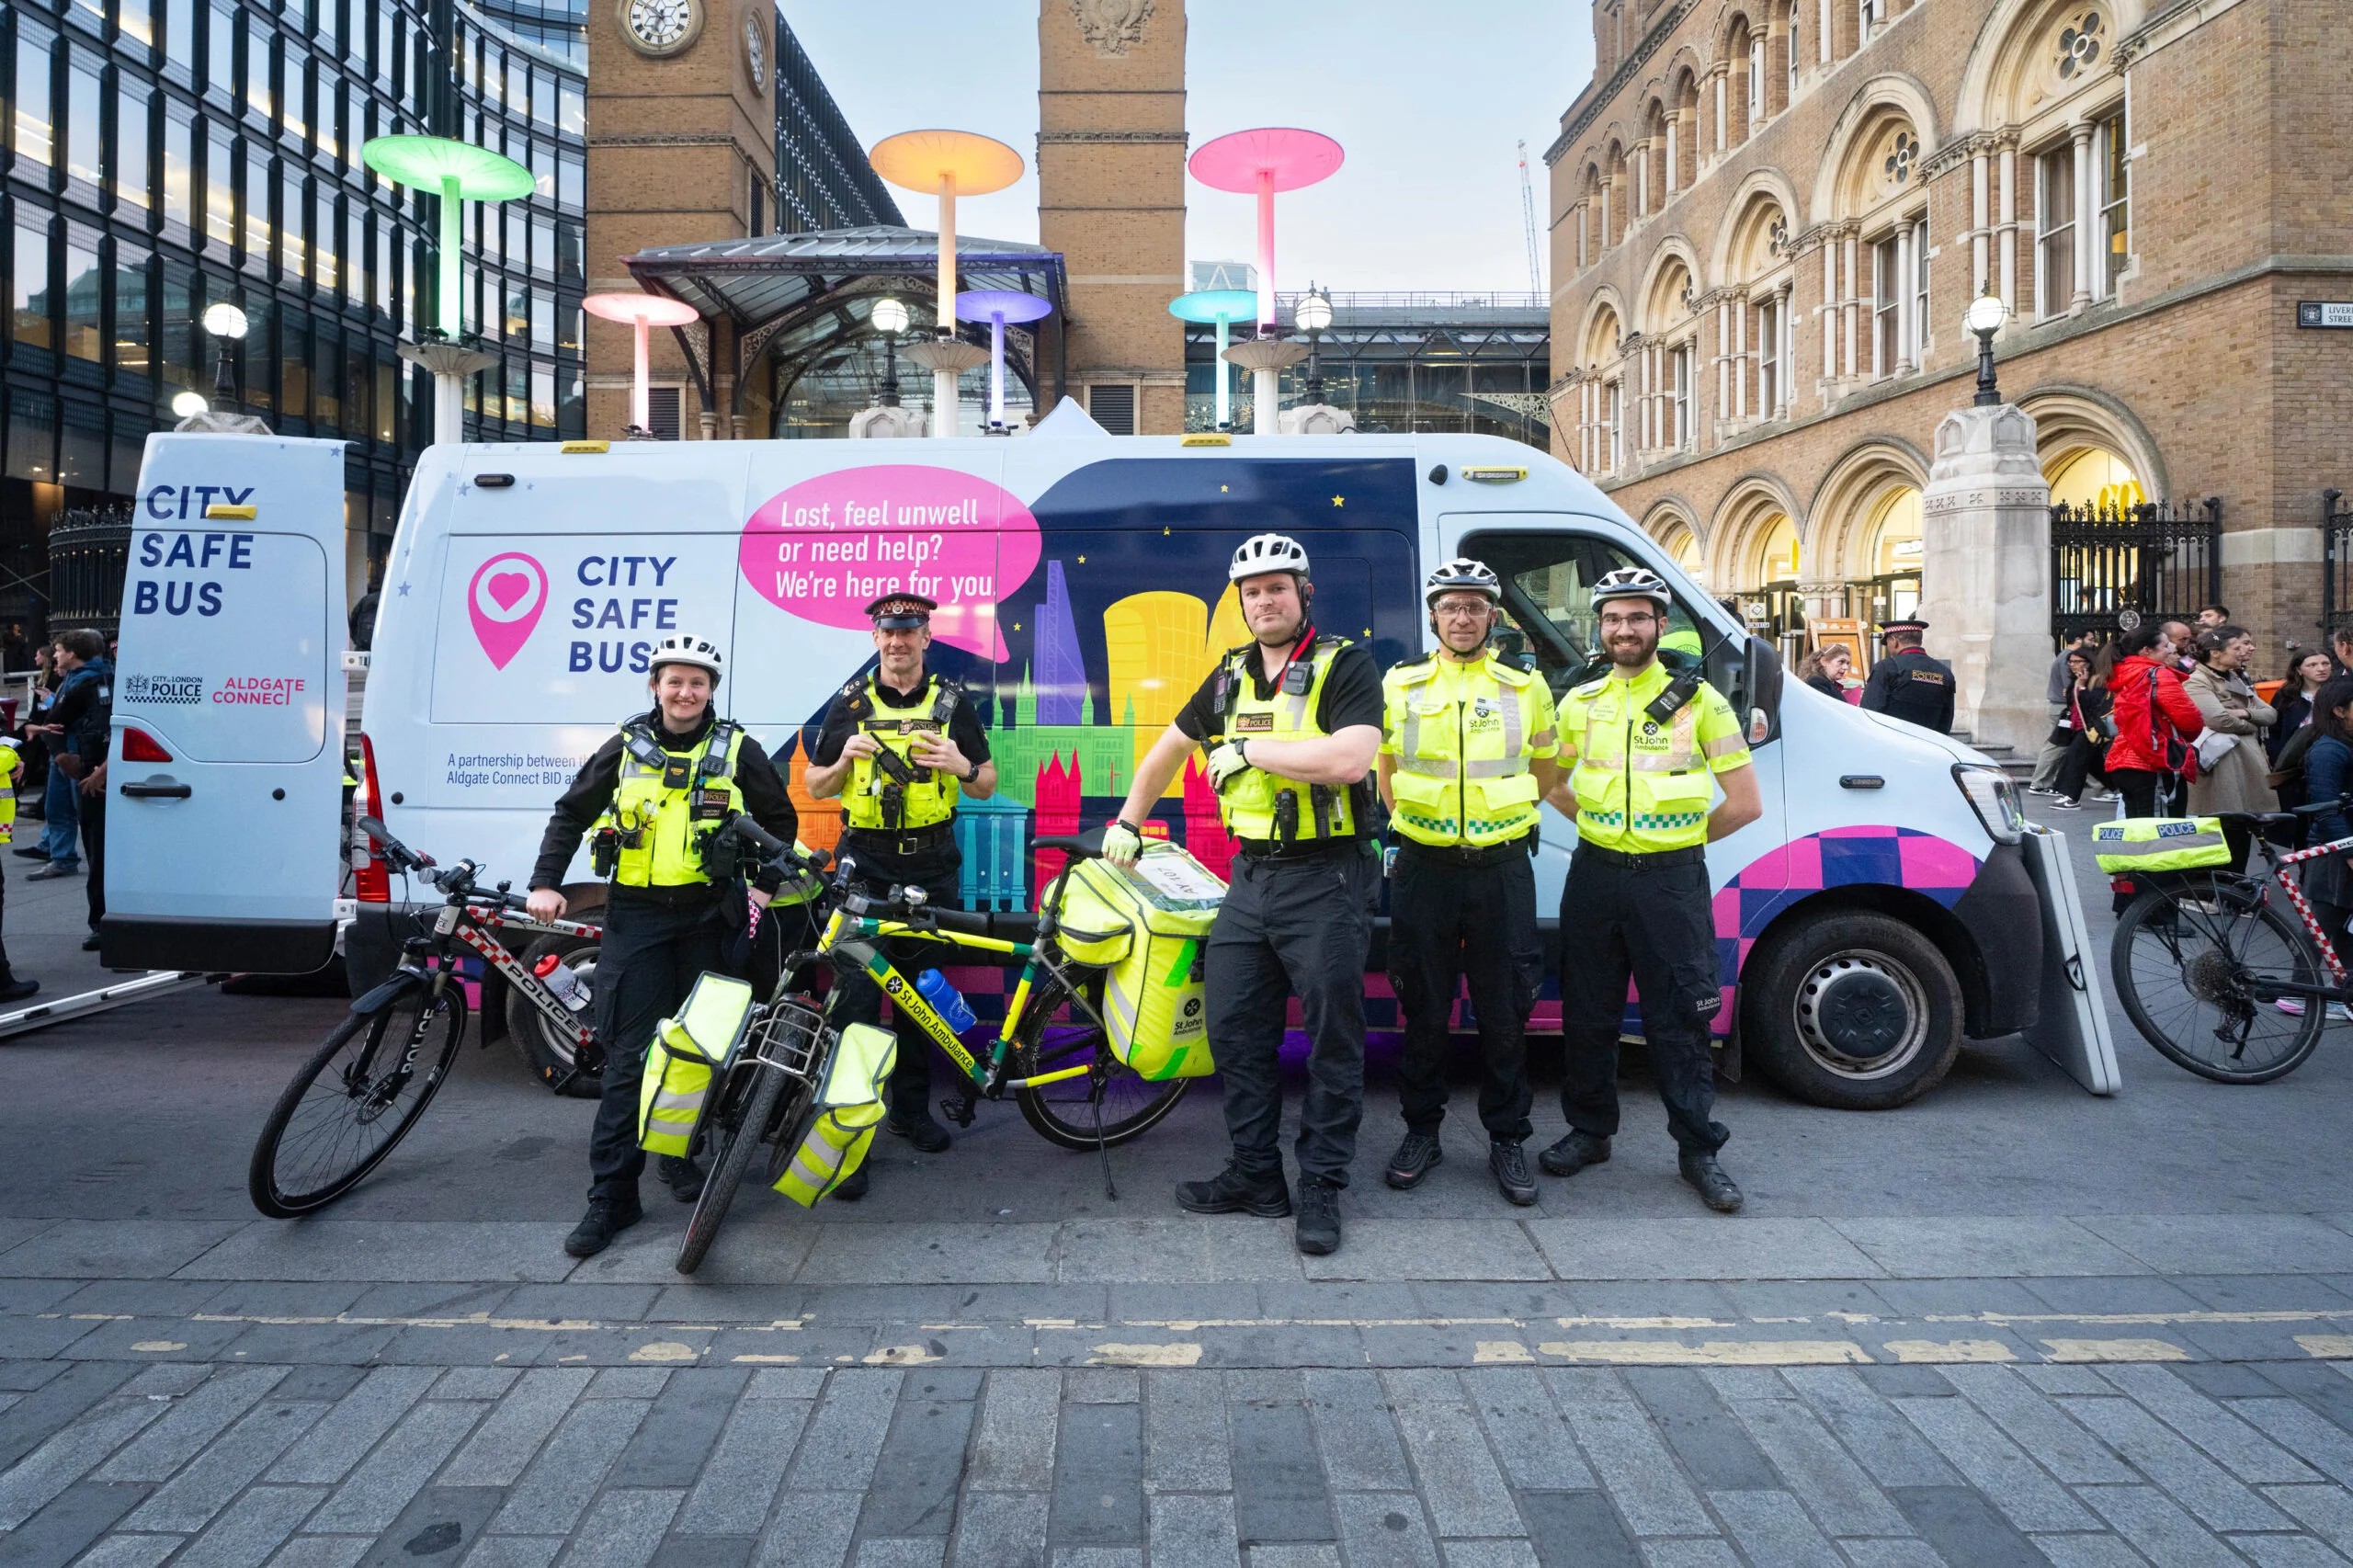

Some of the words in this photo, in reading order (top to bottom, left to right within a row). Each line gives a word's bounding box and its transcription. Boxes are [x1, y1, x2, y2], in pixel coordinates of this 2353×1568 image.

[146, 485, 255, 519] CITY
[781, 502, 835, 530] Lost,
[844, 500, 888, 527] feel
[898, 499, 978, 526] unwell
[140, 533, 254, 569] SAFE
[779, 540, 803, 562] or
[811, 536, 868, 562] need
[877, 534, 943, 567] help?
[577, 556, 676, 586] CITY
[776, 571, 836, 597] We're
[846, 570, 899, 597] here
[908, 570, 941, 597] for
[950, 574, 996, 603] you.
[134, 581, 222, 617] BUS
[572, 598, 678, 630] SAFE
[568, 642, 651, 673] BUS
[1912, 670, 1943, 681] POLICE
[151, 684, 201, 697] POLICE
[224, 677, 305, 692] ALDGATE
[212, 691, 290, 706] CONNECT
[1470, 720, 1476, 728] St
[1478, 719, 1499, 728] John
[1634, 735, 1643, 744] St
[1644, 736, 1667, 745] John
[449, 754, 456, 767] A
[459, 754, 524, 769] partnership
[528, 754, 575, 767] between
[447, 771, 489, 787] Aldgate
[493, 772, 539, 784] Connect
[543, 772, 561, 784] BID
[2099, 829, 2123, 840] POLICE
[2158, 823, 2195, 837] POLICE
[522, 919, 574, 932] OLICE
[507, 965, 579, 1032] POLICE
[1704, 997, 1720, 1006] John
[900, 990, 912, 1005] St
[910, 1001, 932, 1026] John
[929, 1022, 972, 1068] Ambulance
[1184, 1018, 1202, 1028] John
